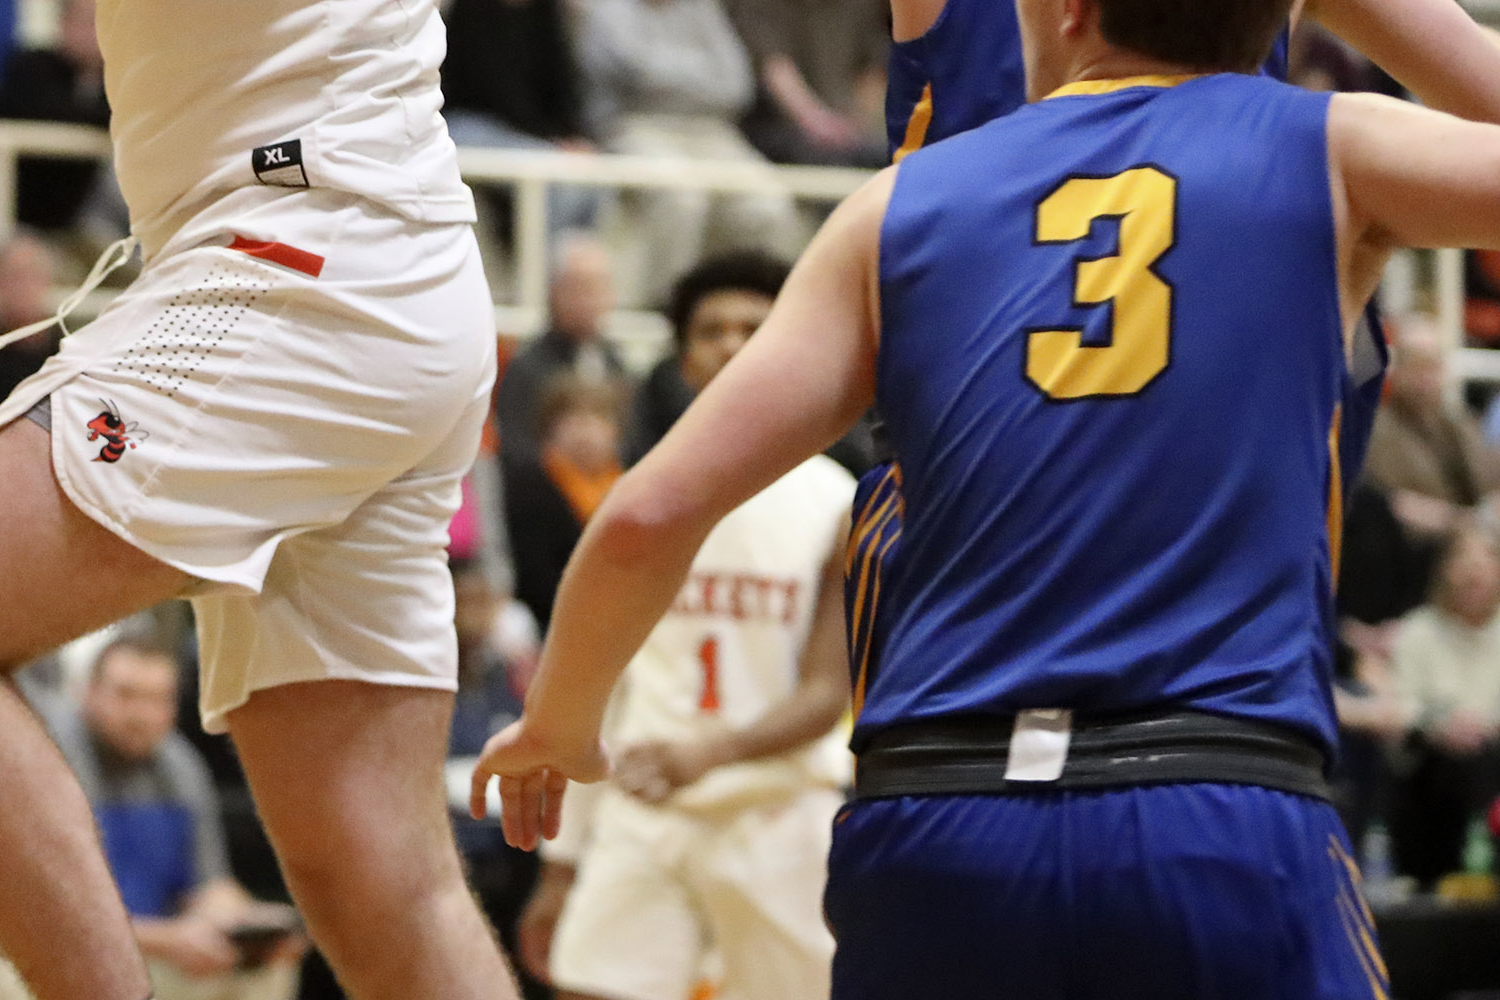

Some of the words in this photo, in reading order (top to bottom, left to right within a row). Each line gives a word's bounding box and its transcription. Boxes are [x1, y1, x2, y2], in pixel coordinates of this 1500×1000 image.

[264, 147, 290, 165] XL
[1022, 161, 1180, 404] 3
[699, 634, 719, 712] 1
